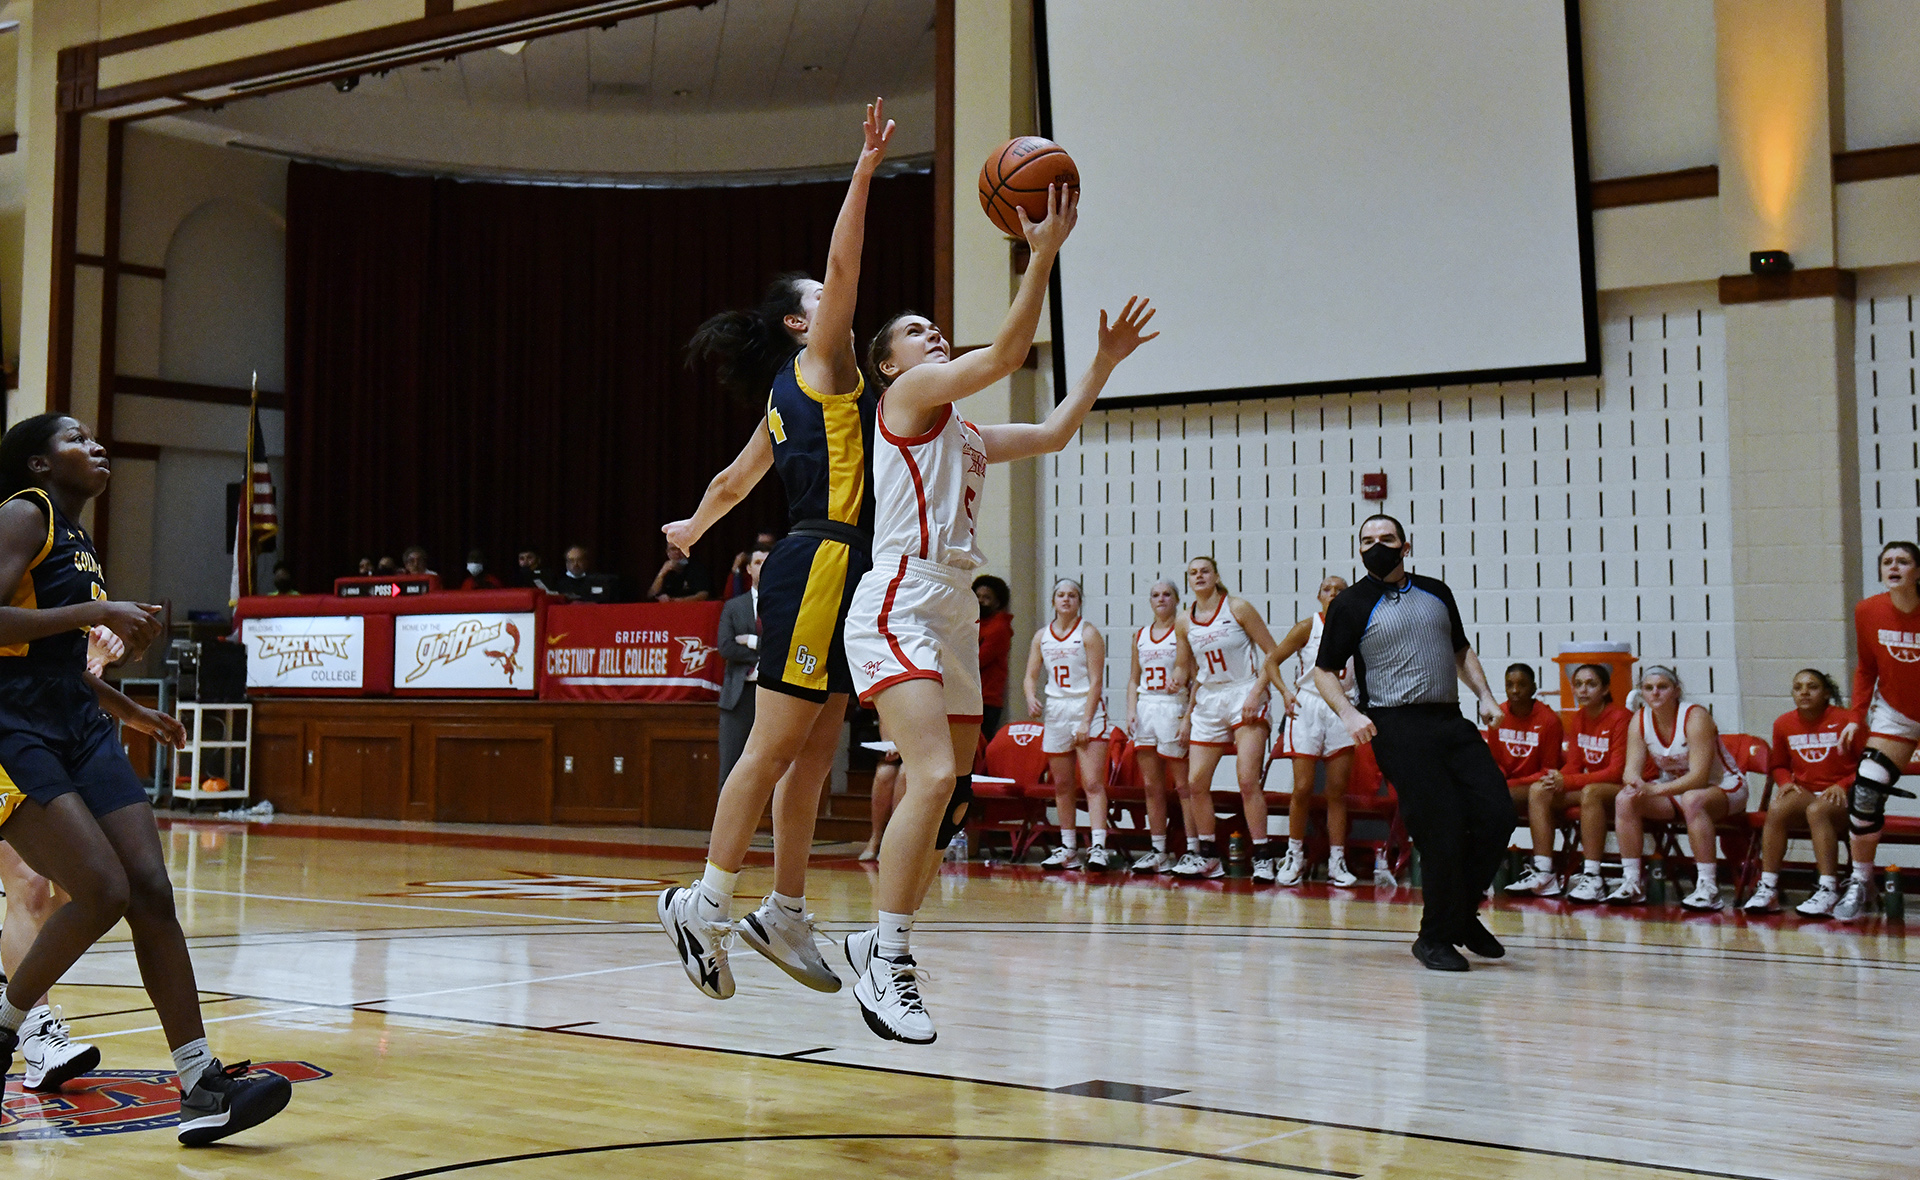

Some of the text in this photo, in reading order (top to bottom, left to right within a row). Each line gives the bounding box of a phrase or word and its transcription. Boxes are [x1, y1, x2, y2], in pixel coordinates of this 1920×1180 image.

[374, 584, 392, 596] POSS
[402, 624, 419, 632] HOME
[615, 630, 669, 644] GRIFFINS
[256, 634, 352, 660] CHESTNUT
[276, 651, 324, 677] HILL
[598, 648, 621, 675] HILL
[624, 648, 668, 676] COLLEGE
[1205, 648, 1228, 675] 14
[311, 670, 357, 682] COLLEGE
[1053, 665, 1071, 688] 12
[1145, 666, 1166, 691] 23
